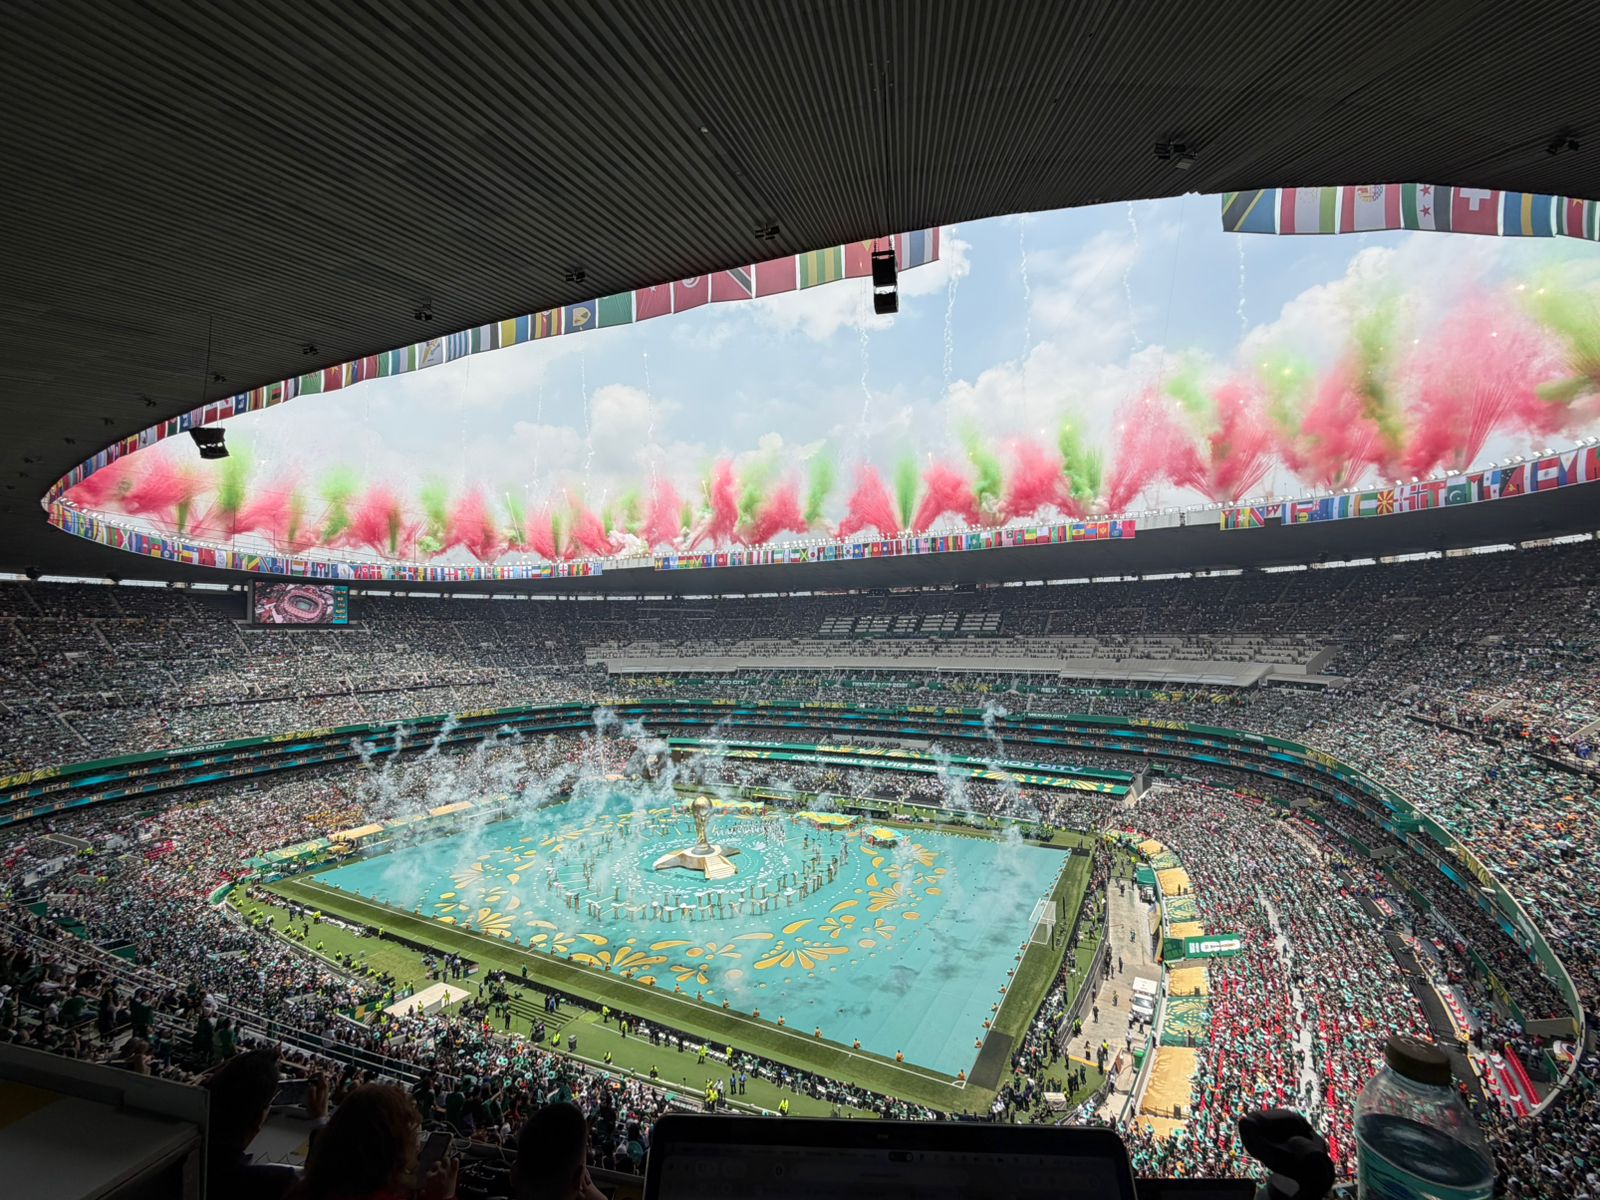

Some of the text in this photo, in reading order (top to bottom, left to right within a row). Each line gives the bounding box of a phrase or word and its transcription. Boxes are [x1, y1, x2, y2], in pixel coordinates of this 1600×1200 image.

[166, 746, 204, 754] MEXICO
[817, 756, 858, 764] MUNDIAL
[966, 756, 1084, 772] MEXICO CITY
